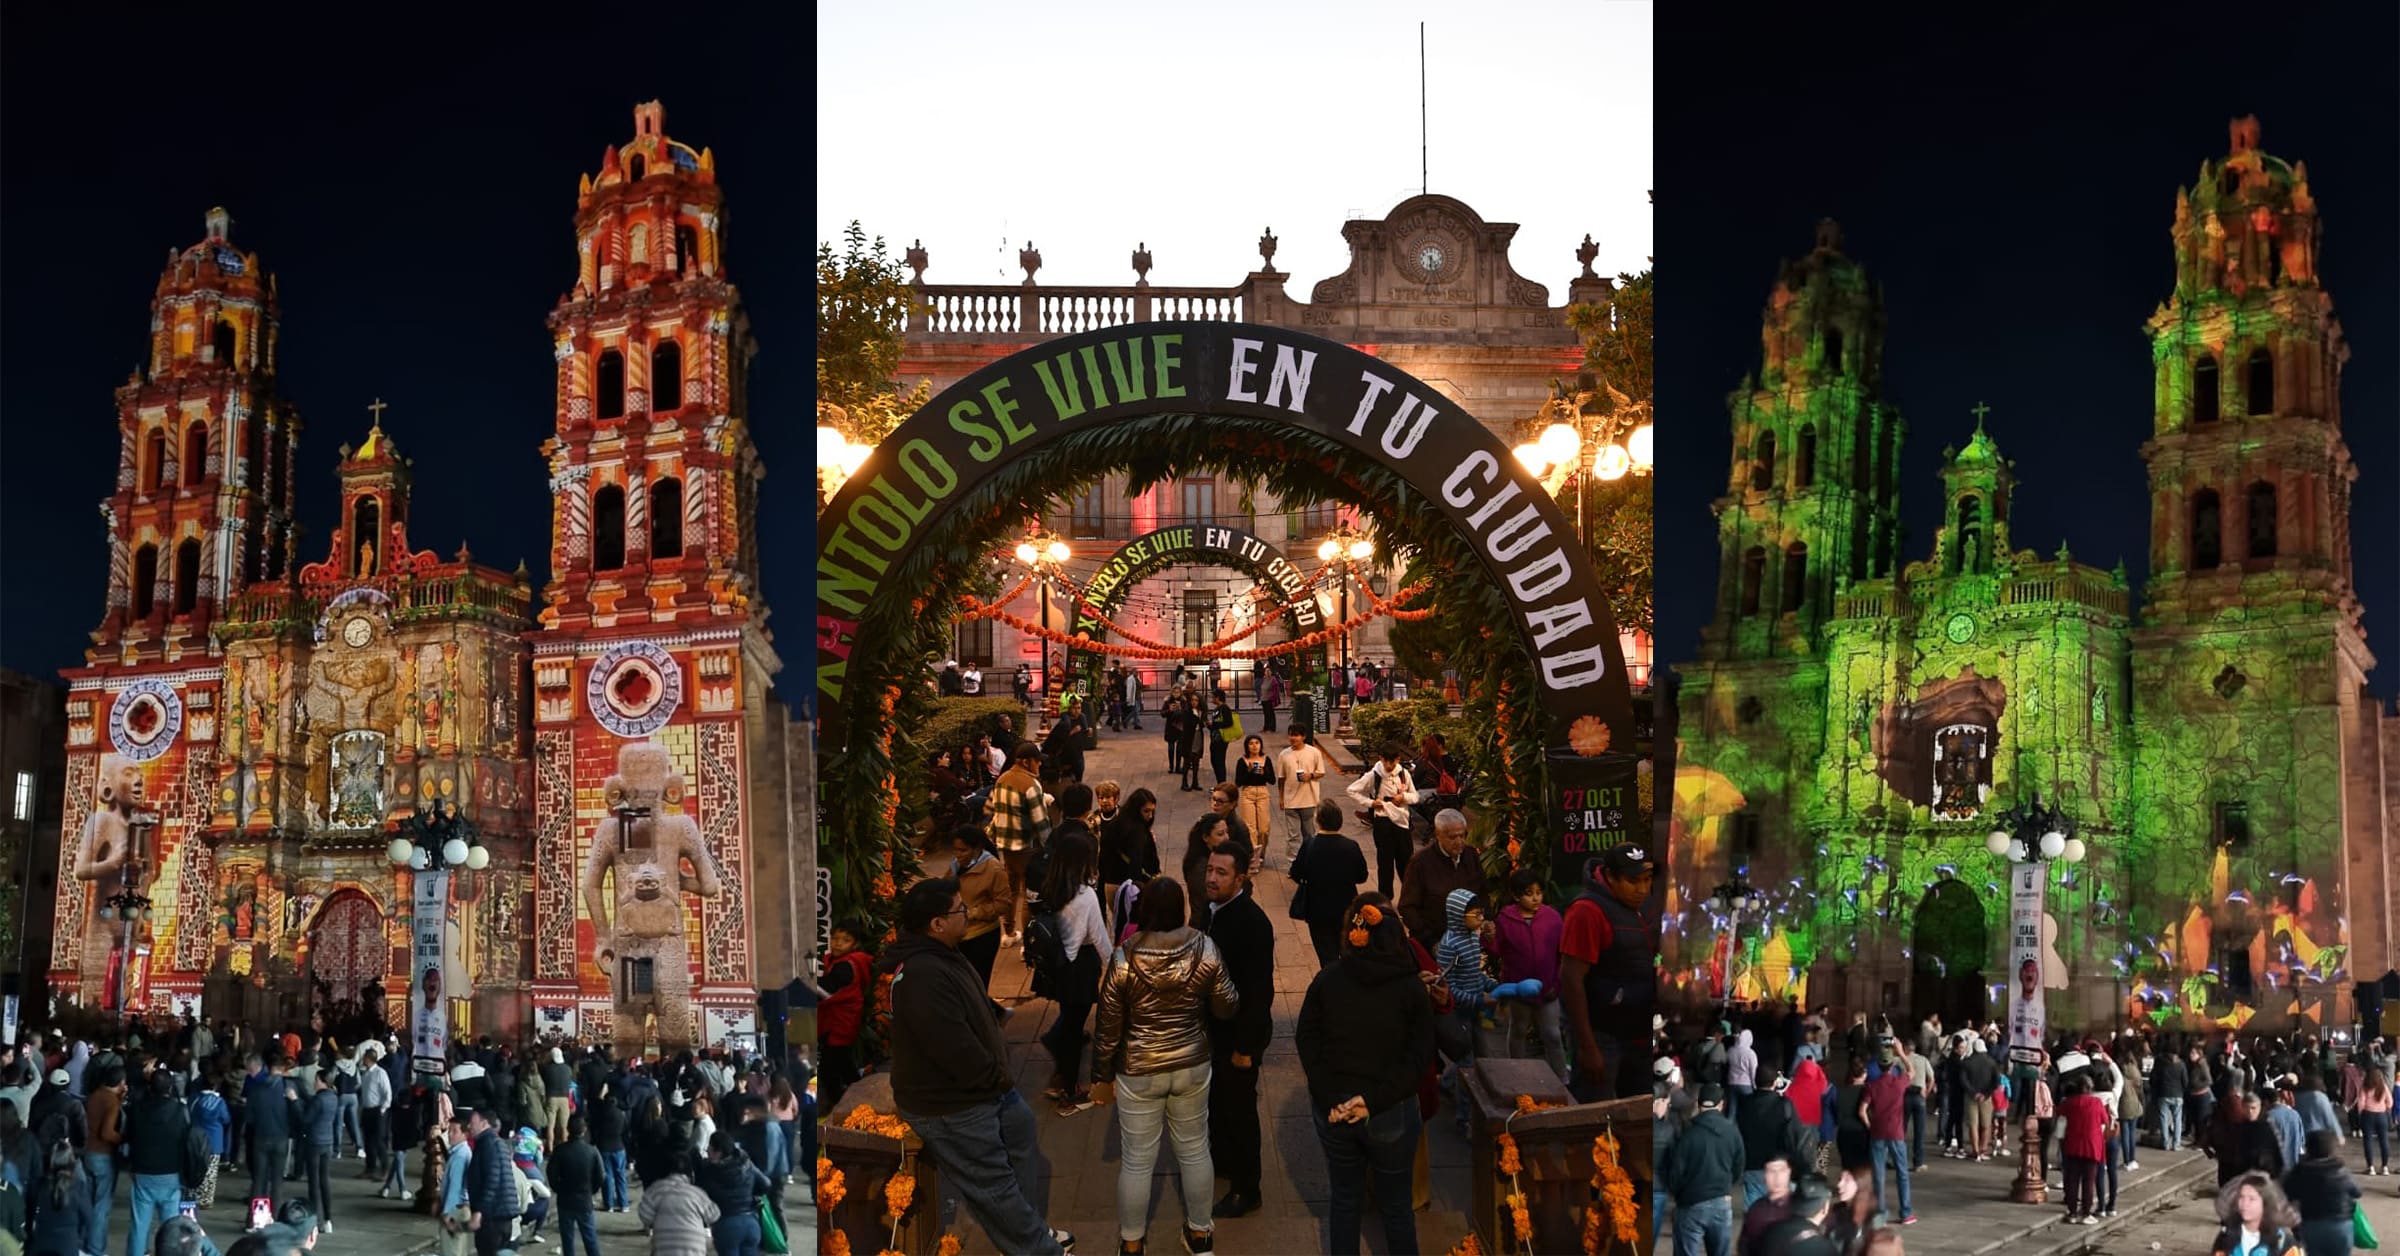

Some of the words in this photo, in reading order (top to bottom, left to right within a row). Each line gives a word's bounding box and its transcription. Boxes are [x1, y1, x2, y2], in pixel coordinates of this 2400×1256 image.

[948, 376, 1037, 462] SE
[1032, 334, 1186, 421] VIVE
[1226, 338, 1318, 413] EN
[1346, 370, 1439, 459] TU
[1441, 450, 1605, 690] CIUDAD
[1126, 540, 1151, 565] SE
[1150, 529, 1193, 554] VIVE
[1205, 528, 1231, 549] EN
[1240, 536, 1267, 561] TU
[1584, 810, 1607, 830] AL
